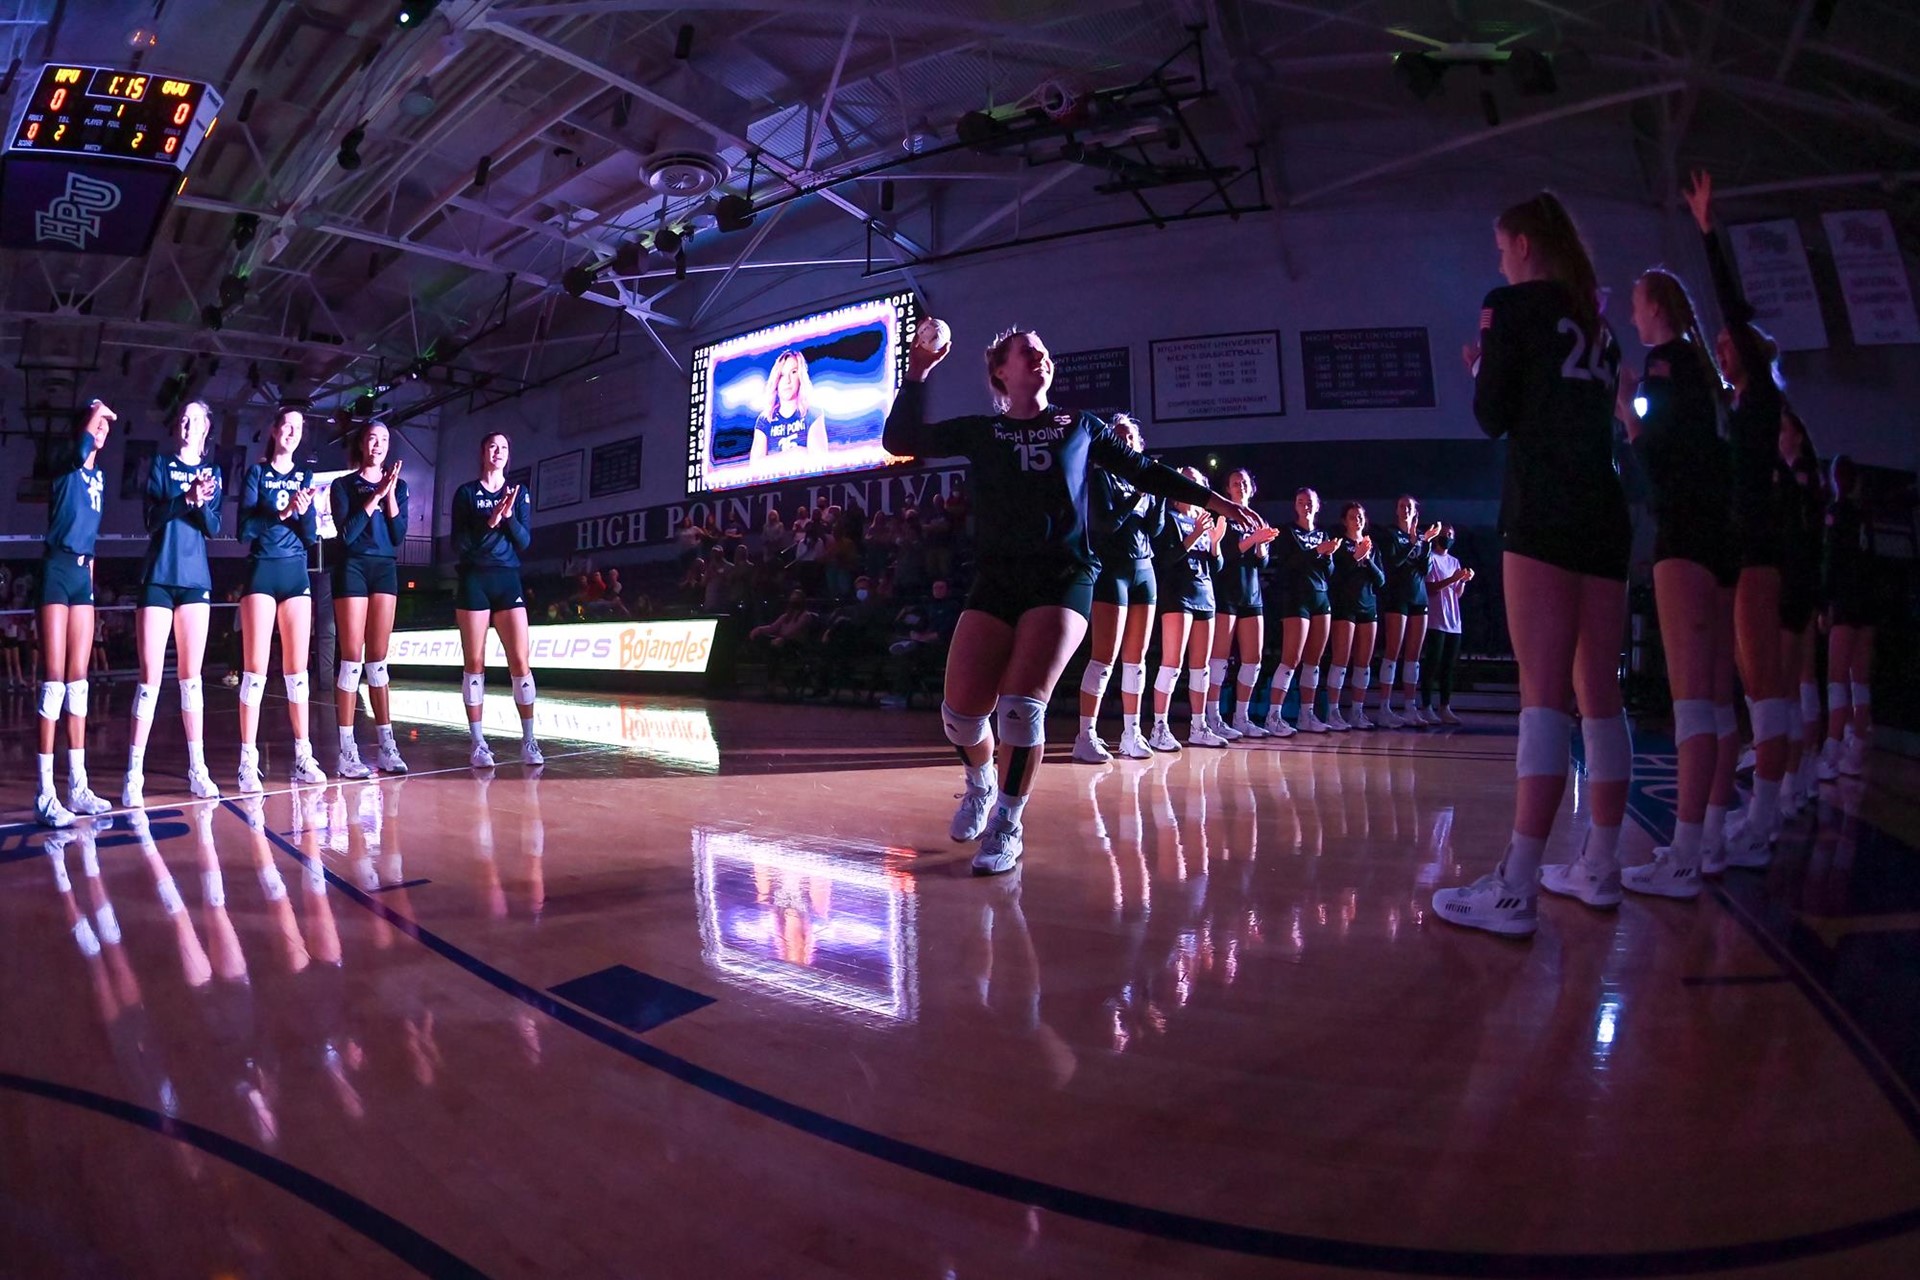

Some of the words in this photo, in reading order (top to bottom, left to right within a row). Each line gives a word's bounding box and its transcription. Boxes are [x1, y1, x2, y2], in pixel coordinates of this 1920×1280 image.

[108, 76, 147, 99] 1:15
[50, 88, 67, 111] 0
[116, 104, 125, 118] 1
[173, 103, 190, 125] 0
[26, 122, 39, 140] 0
[53, 124, 66, 141] 2
[131, 132, 143, 148] 2
[164, 136, 177, 153] 0
[35, 171, 122, 250] HPU
[1028, 427, 1065, 442] POINT
[1013, 442, 1053, 472] 15
[276, 489, 290, 511] 8
[576, 511, 649, 551] HIGH
[665, 491, 782, 538] POINT
[398, 640, 464, 657] STARTI
[495, 639, 612, 659] LEUPS
[619, 627, 709, 669] Bojangles
